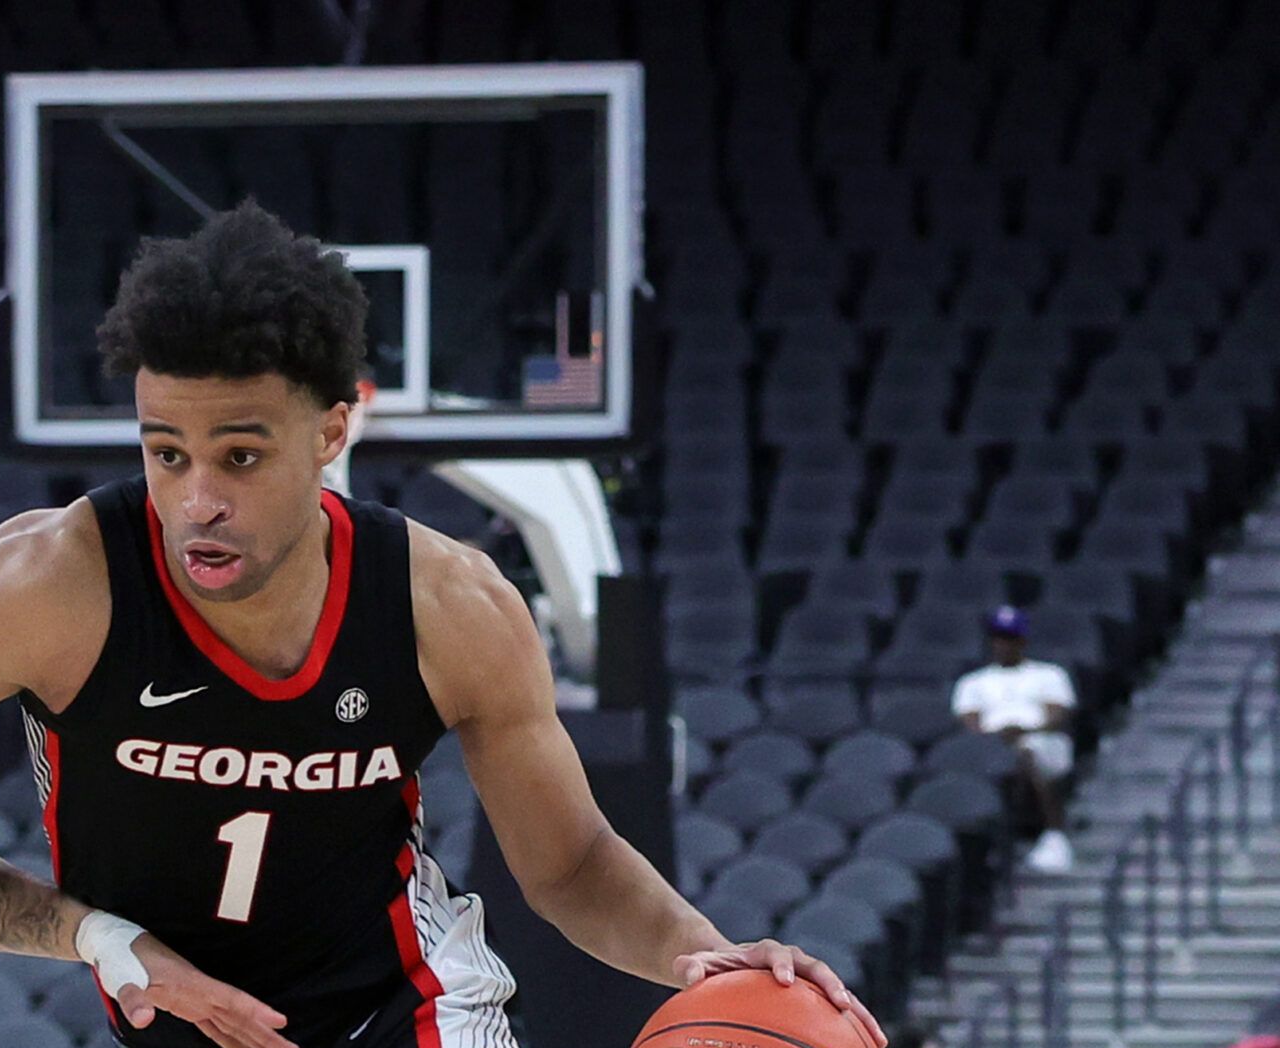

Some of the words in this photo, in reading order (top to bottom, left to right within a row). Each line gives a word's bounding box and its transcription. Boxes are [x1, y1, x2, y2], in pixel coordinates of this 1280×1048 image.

[339, 691, 367, 719] SEC
[115, 738, 403, 792] GEORGIA
[216, 811, 272, 923] 1
